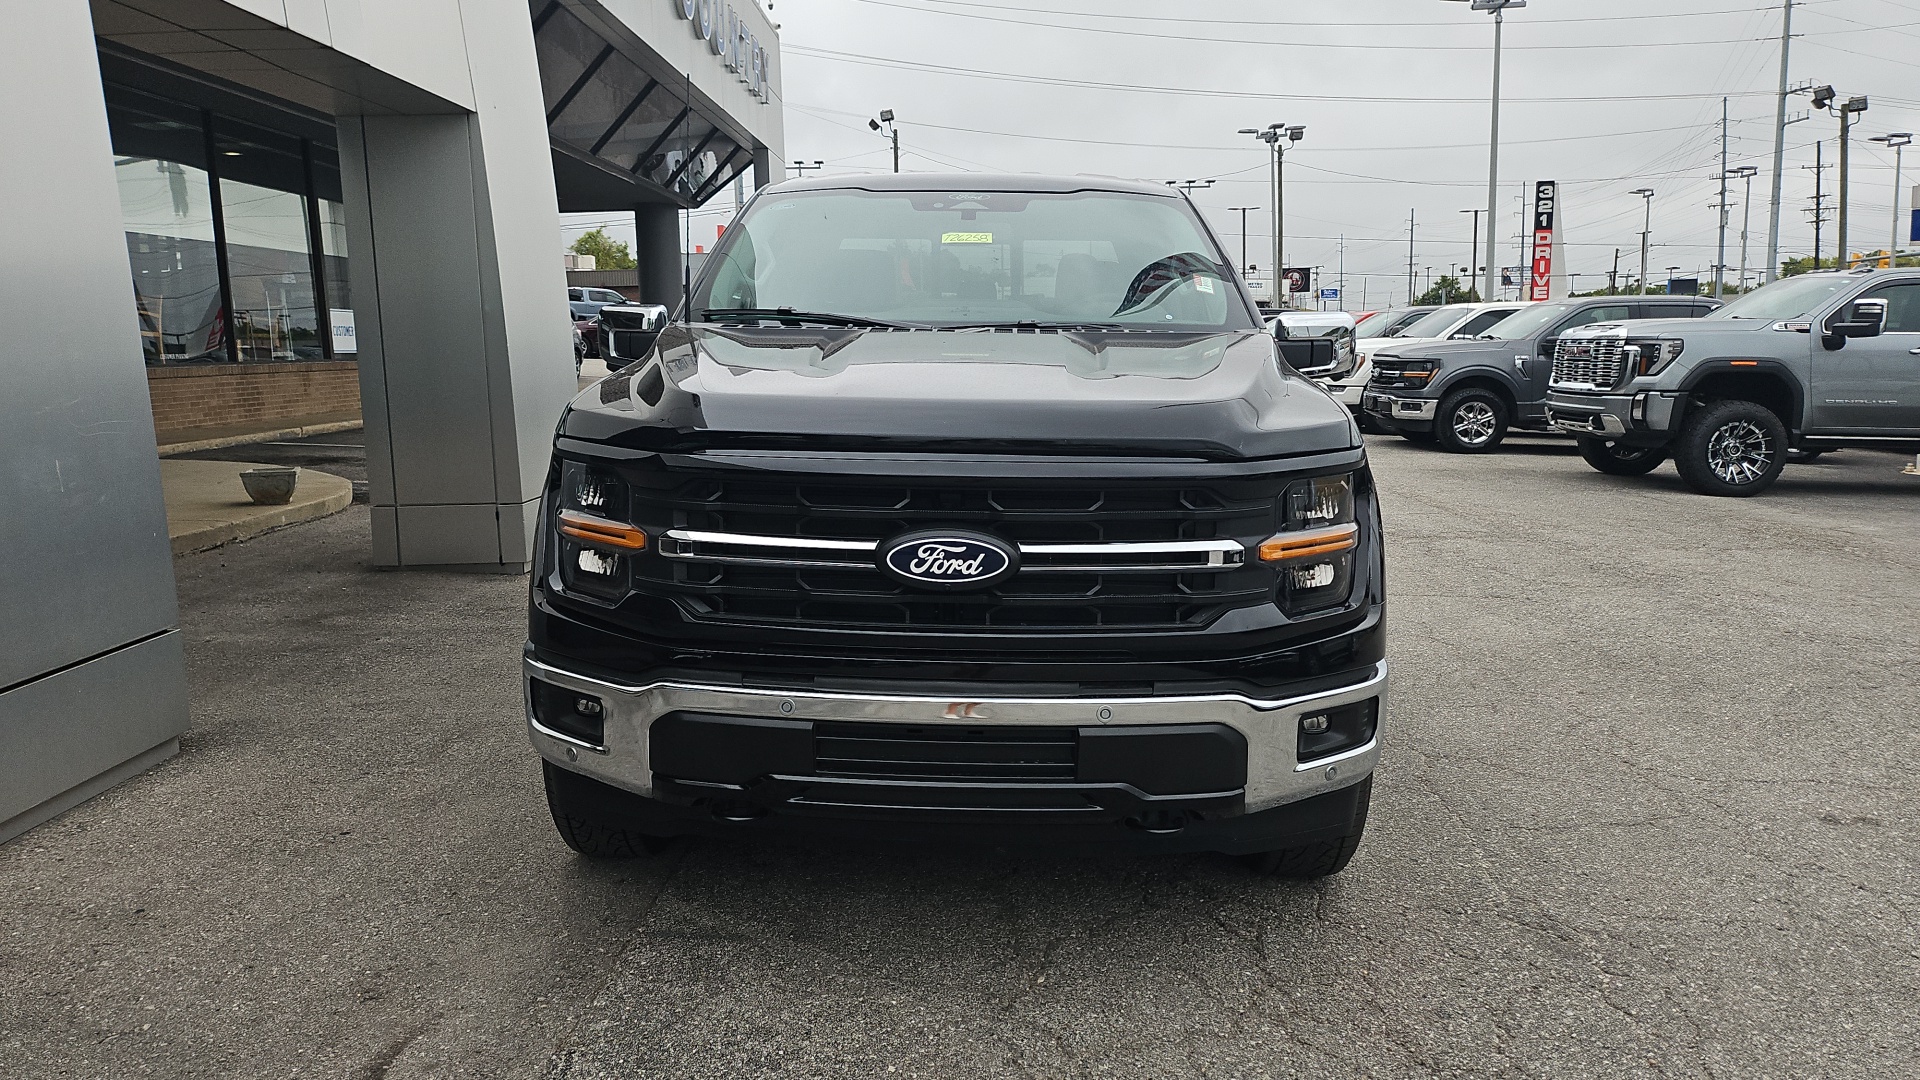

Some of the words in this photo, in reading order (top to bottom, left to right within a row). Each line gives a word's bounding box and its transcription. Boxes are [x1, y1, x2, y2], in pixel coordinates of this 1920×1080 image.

[1538, 185, 1554, 227] 321
[1533, 233, 1552, 299] DRIVE
[333, 325, 354, 337] CUSTOMER
[909, 544, 986, 575] Ford
